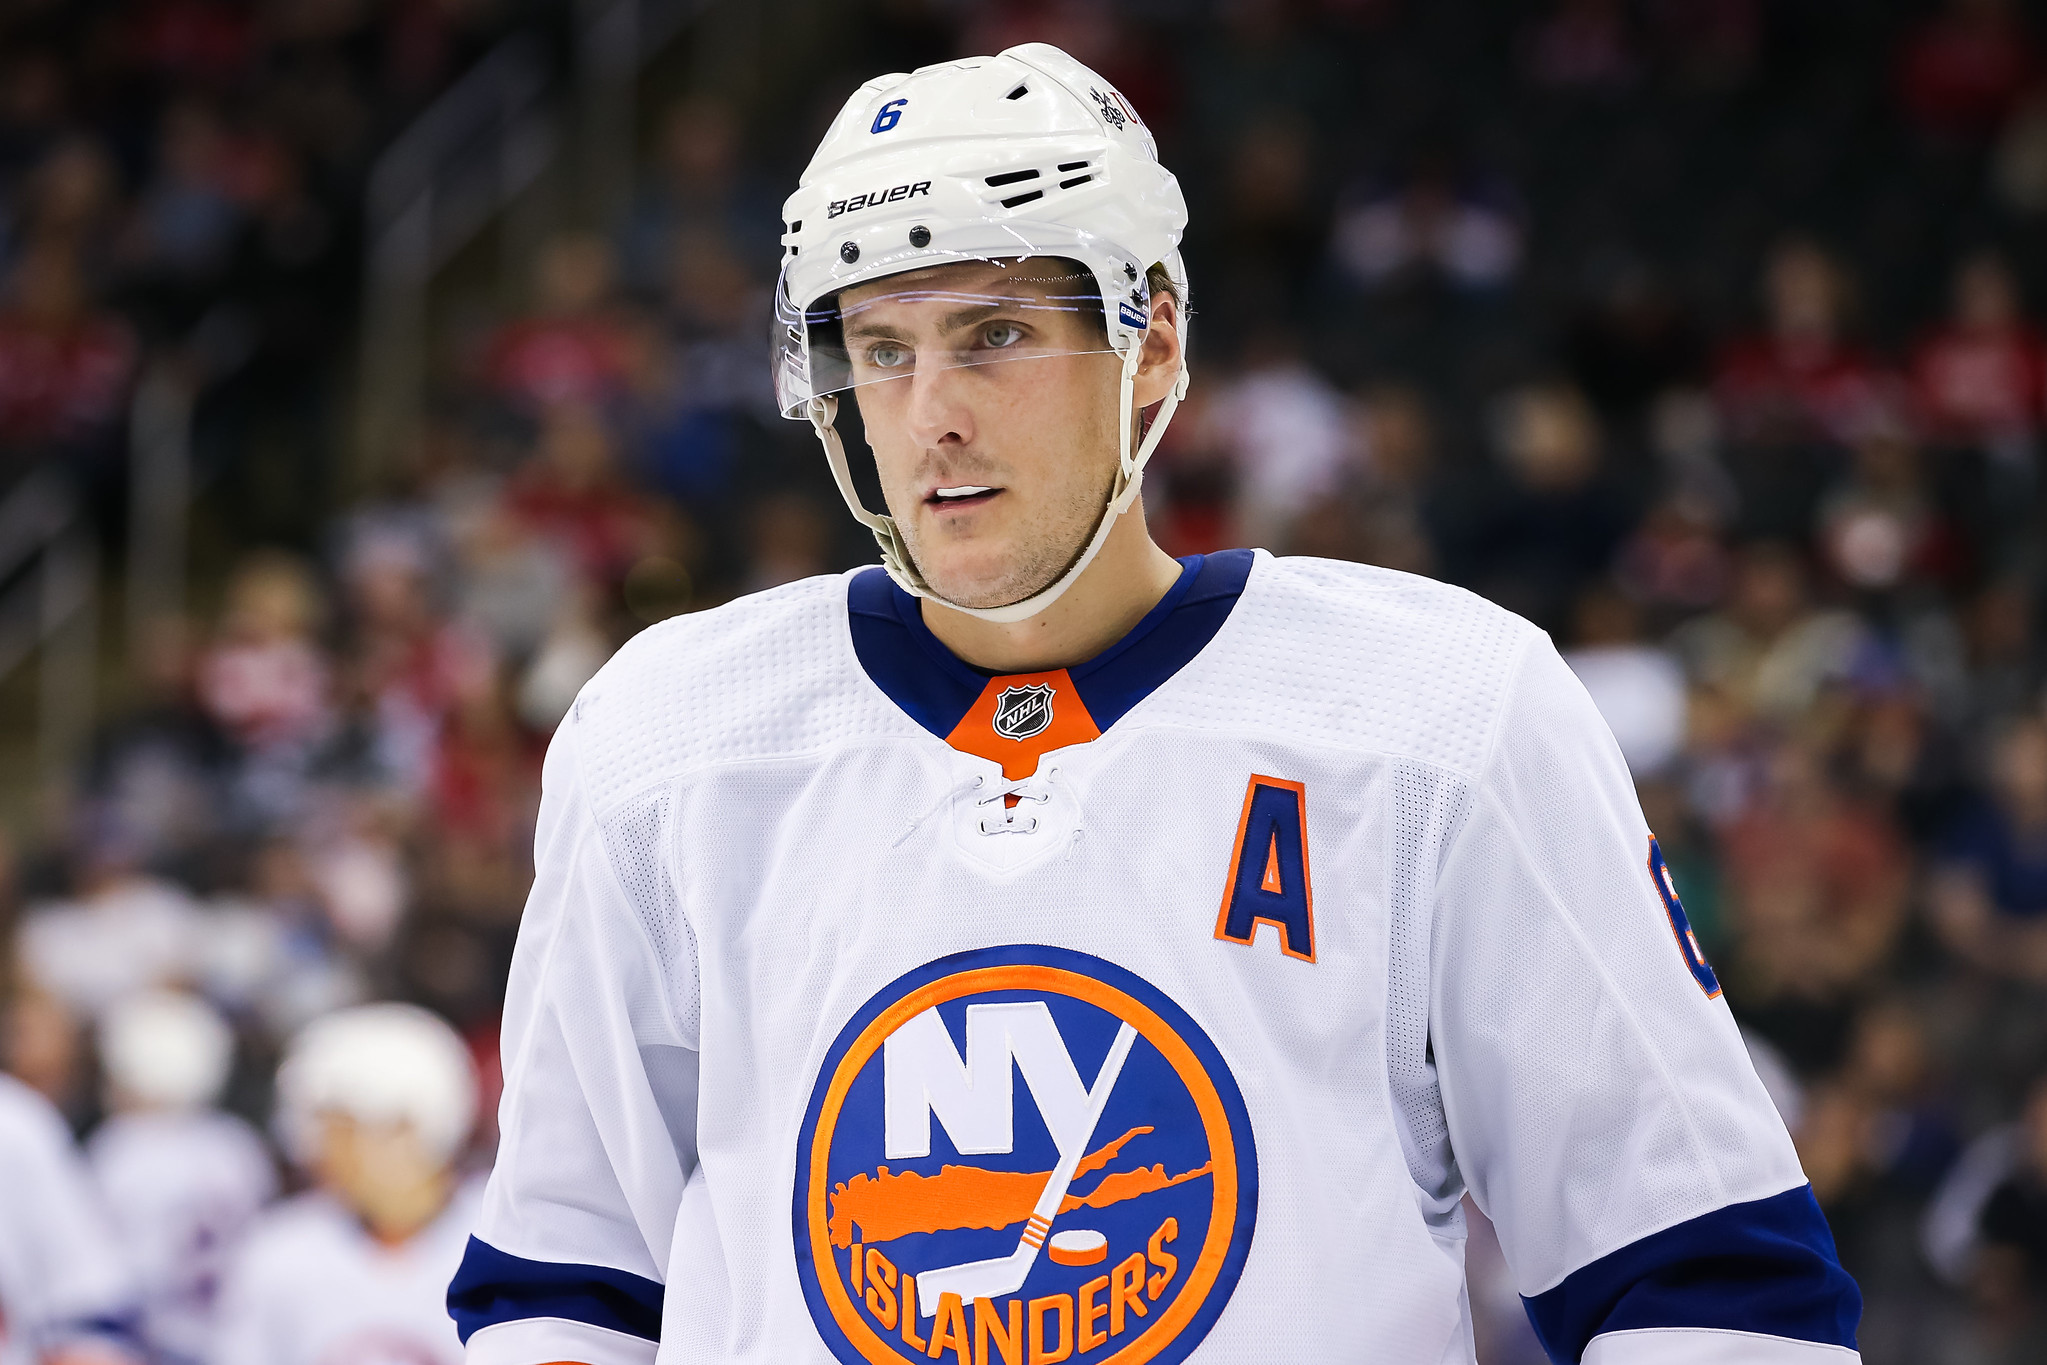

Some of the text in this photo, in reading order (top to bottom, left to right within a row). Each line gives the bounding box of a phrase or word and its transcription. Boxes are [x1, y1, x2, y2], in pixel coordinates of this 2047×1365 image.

[870, 98, 908, 135] 6
[1006, 697, 1042, 729] NHL
[1214, 773, 1317, 964] A
[884, 1001, 1138, 1175] NY
[850, 1217, 1180, 1365] ISLANDERS
